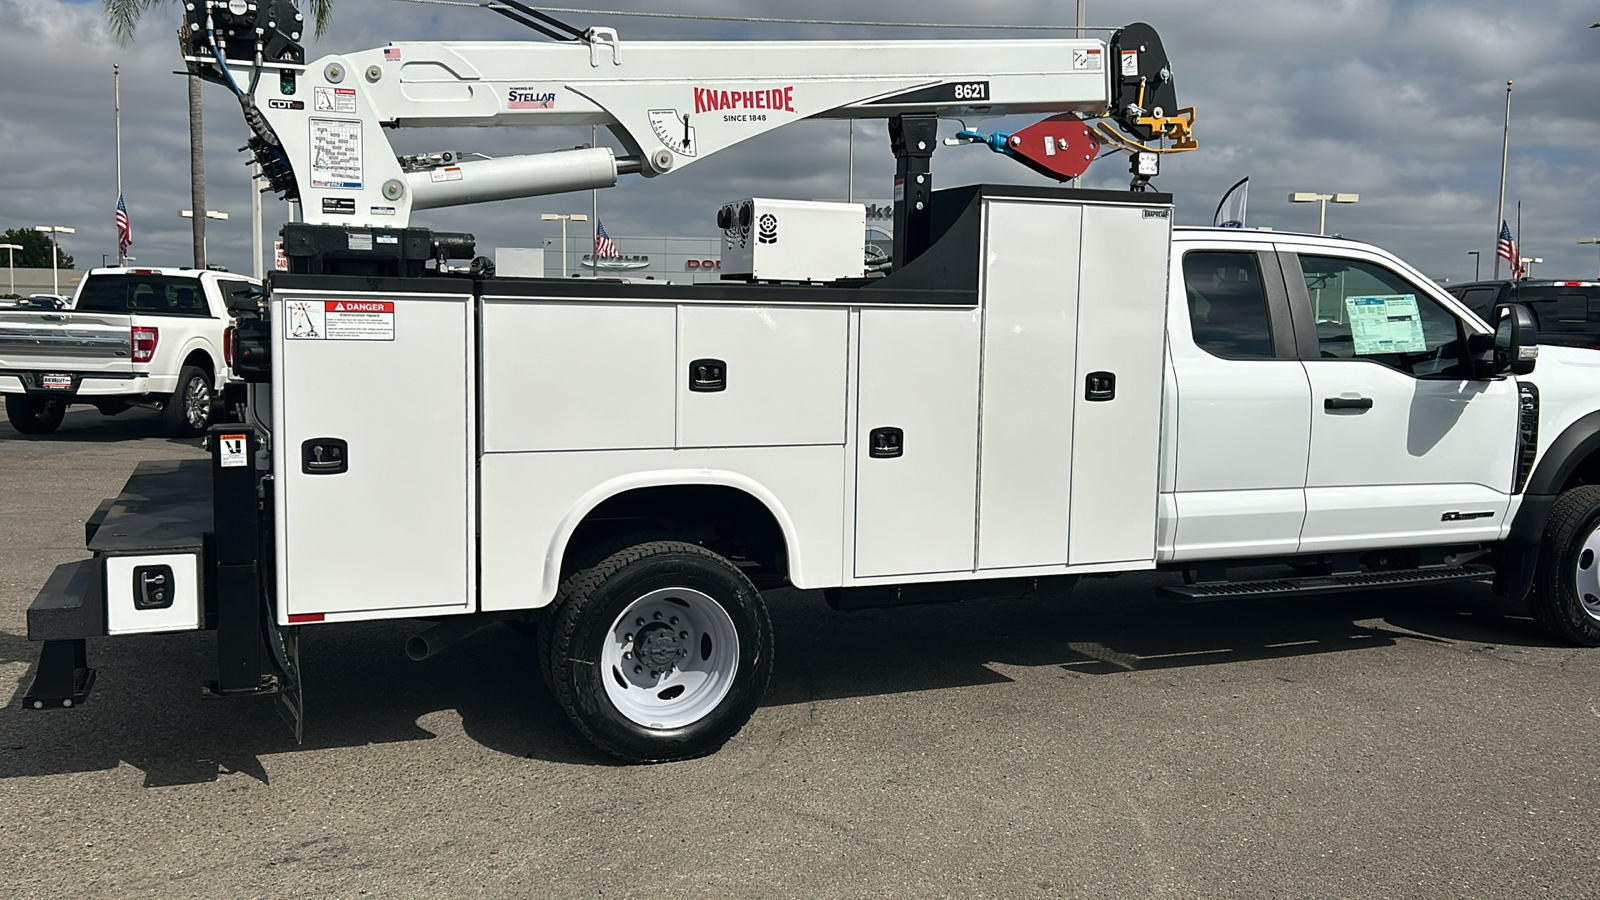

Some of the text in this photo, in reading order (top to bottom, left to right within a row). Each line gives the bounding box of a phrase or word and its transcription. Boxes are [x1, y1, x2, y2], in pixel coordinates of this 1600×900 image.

[508, 90, 555, 102] STELLAR
[954, 84, 985, 99] 8621
[693, 86, 795, 114] KNAPHEIDE
[749, 114, 767, 122] 1848
[346, 303, 384, 311] DANGER
